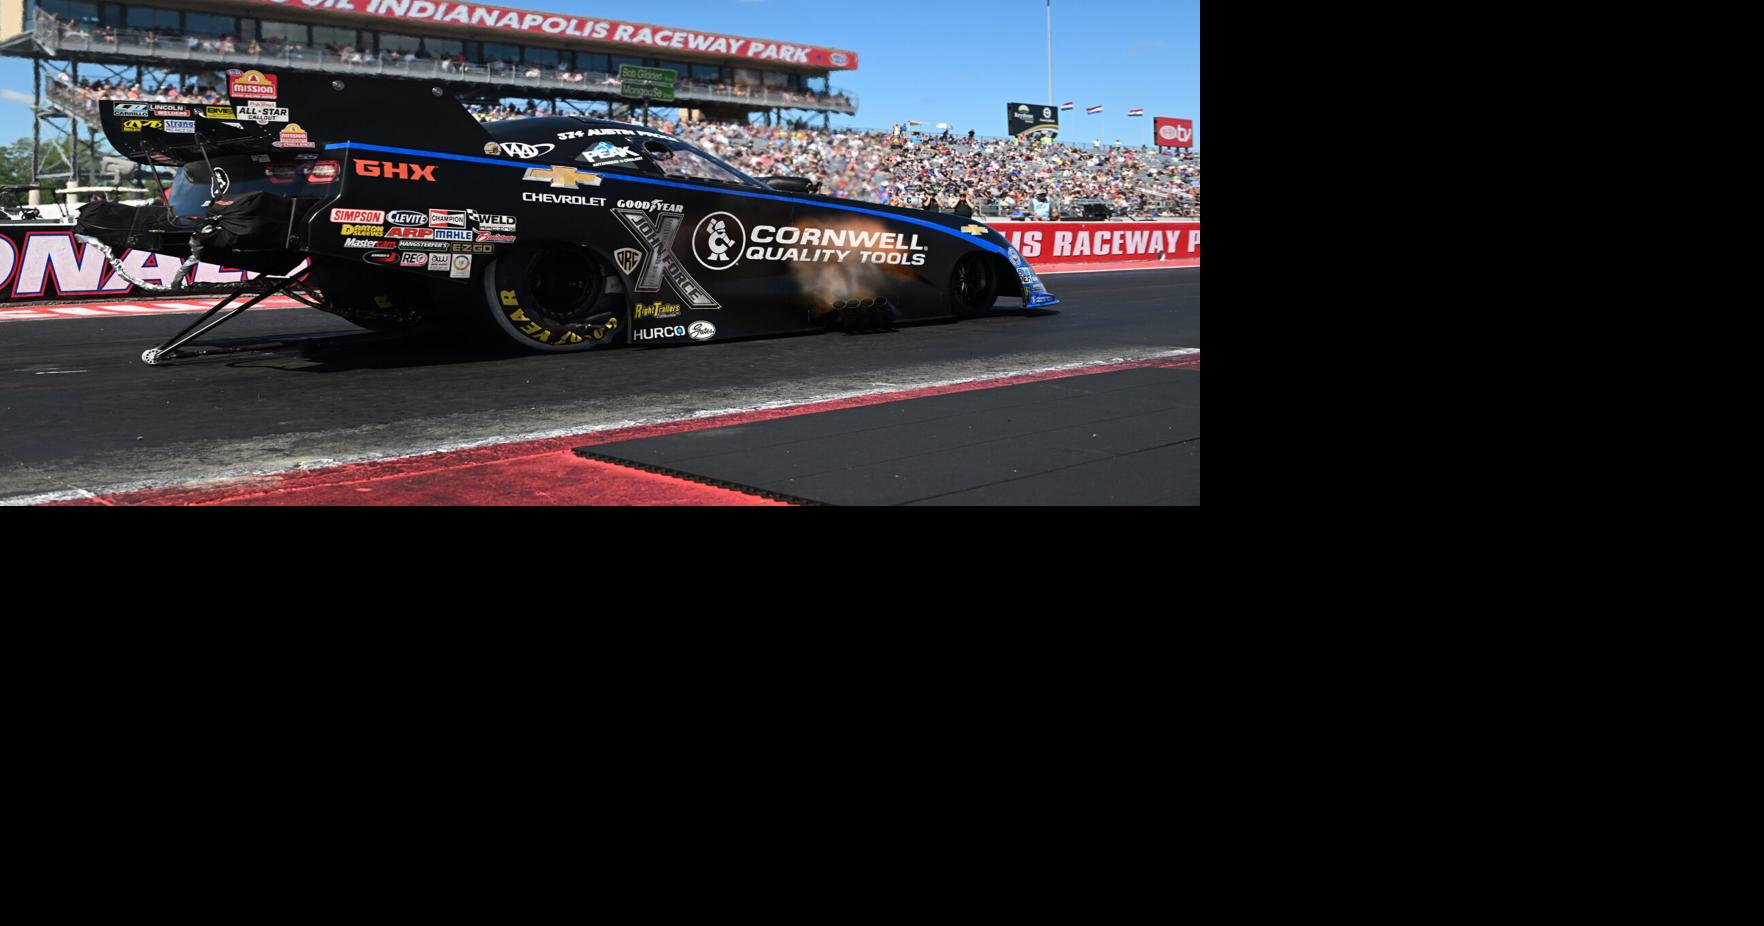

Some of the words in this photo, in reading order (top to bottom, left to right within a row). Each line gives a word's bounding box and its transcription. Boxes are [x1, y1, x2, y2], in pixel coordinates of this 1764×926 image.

[366, 0, 608, 38] INDIANAPOLIS
[613, 24, 746, 54] RACEWAY
[747, 43, 811, 64] PARK
[582, 146, 640, 163] PEAK
[352, 158, 439, 182] GHX
[522, 192, 607, 207] CHEVROLET
[616, 199, 684, 213] GOODYEAR
[334, 209, 382, 222] SIMPSON
[386, 210, 428, 224] CLEVITE
[431, 215, 464, 223] CHAMPION
[479, 214, 516, 226] WELD
[386, 226, 434, 239] ARP
[750, 225, 924, 251] CORNWELL
[1052, 230, 1181, 257] RACEWAY
[630, 213, 667, 256] JOHN
[662, 254, 703, 302] FORCE
[745, 246, 850, 263] QUALITY
[859, 250, 926, 266] TOOLS
[633, 326, 686, 341] HURCO
